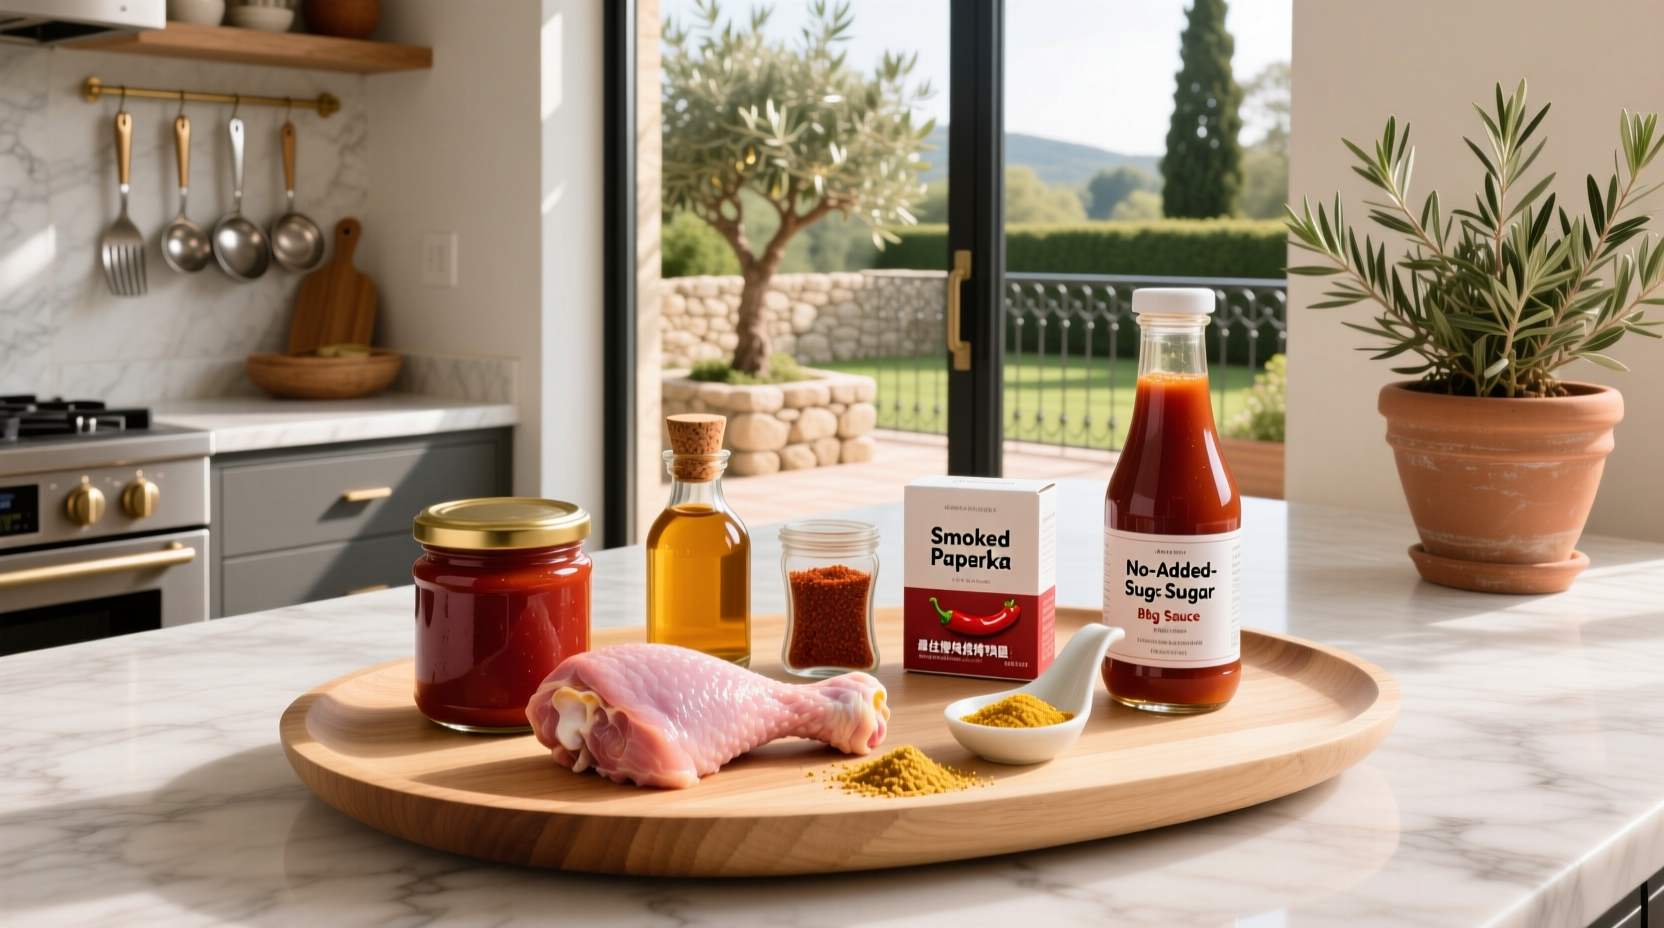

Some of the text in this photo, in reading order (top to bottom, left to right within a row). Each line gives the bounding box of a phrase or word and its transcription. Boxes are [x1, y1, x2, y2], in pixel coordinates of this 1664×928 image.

[931, 527, 1010, 547] Smoked
[931, 548, 1011, 572] Paperka
[1126, 559, 1217, 578] No-Added-
[1165, 583, 1215, 604] Sugar
[1164, 610, 1200, 622] Sauce
